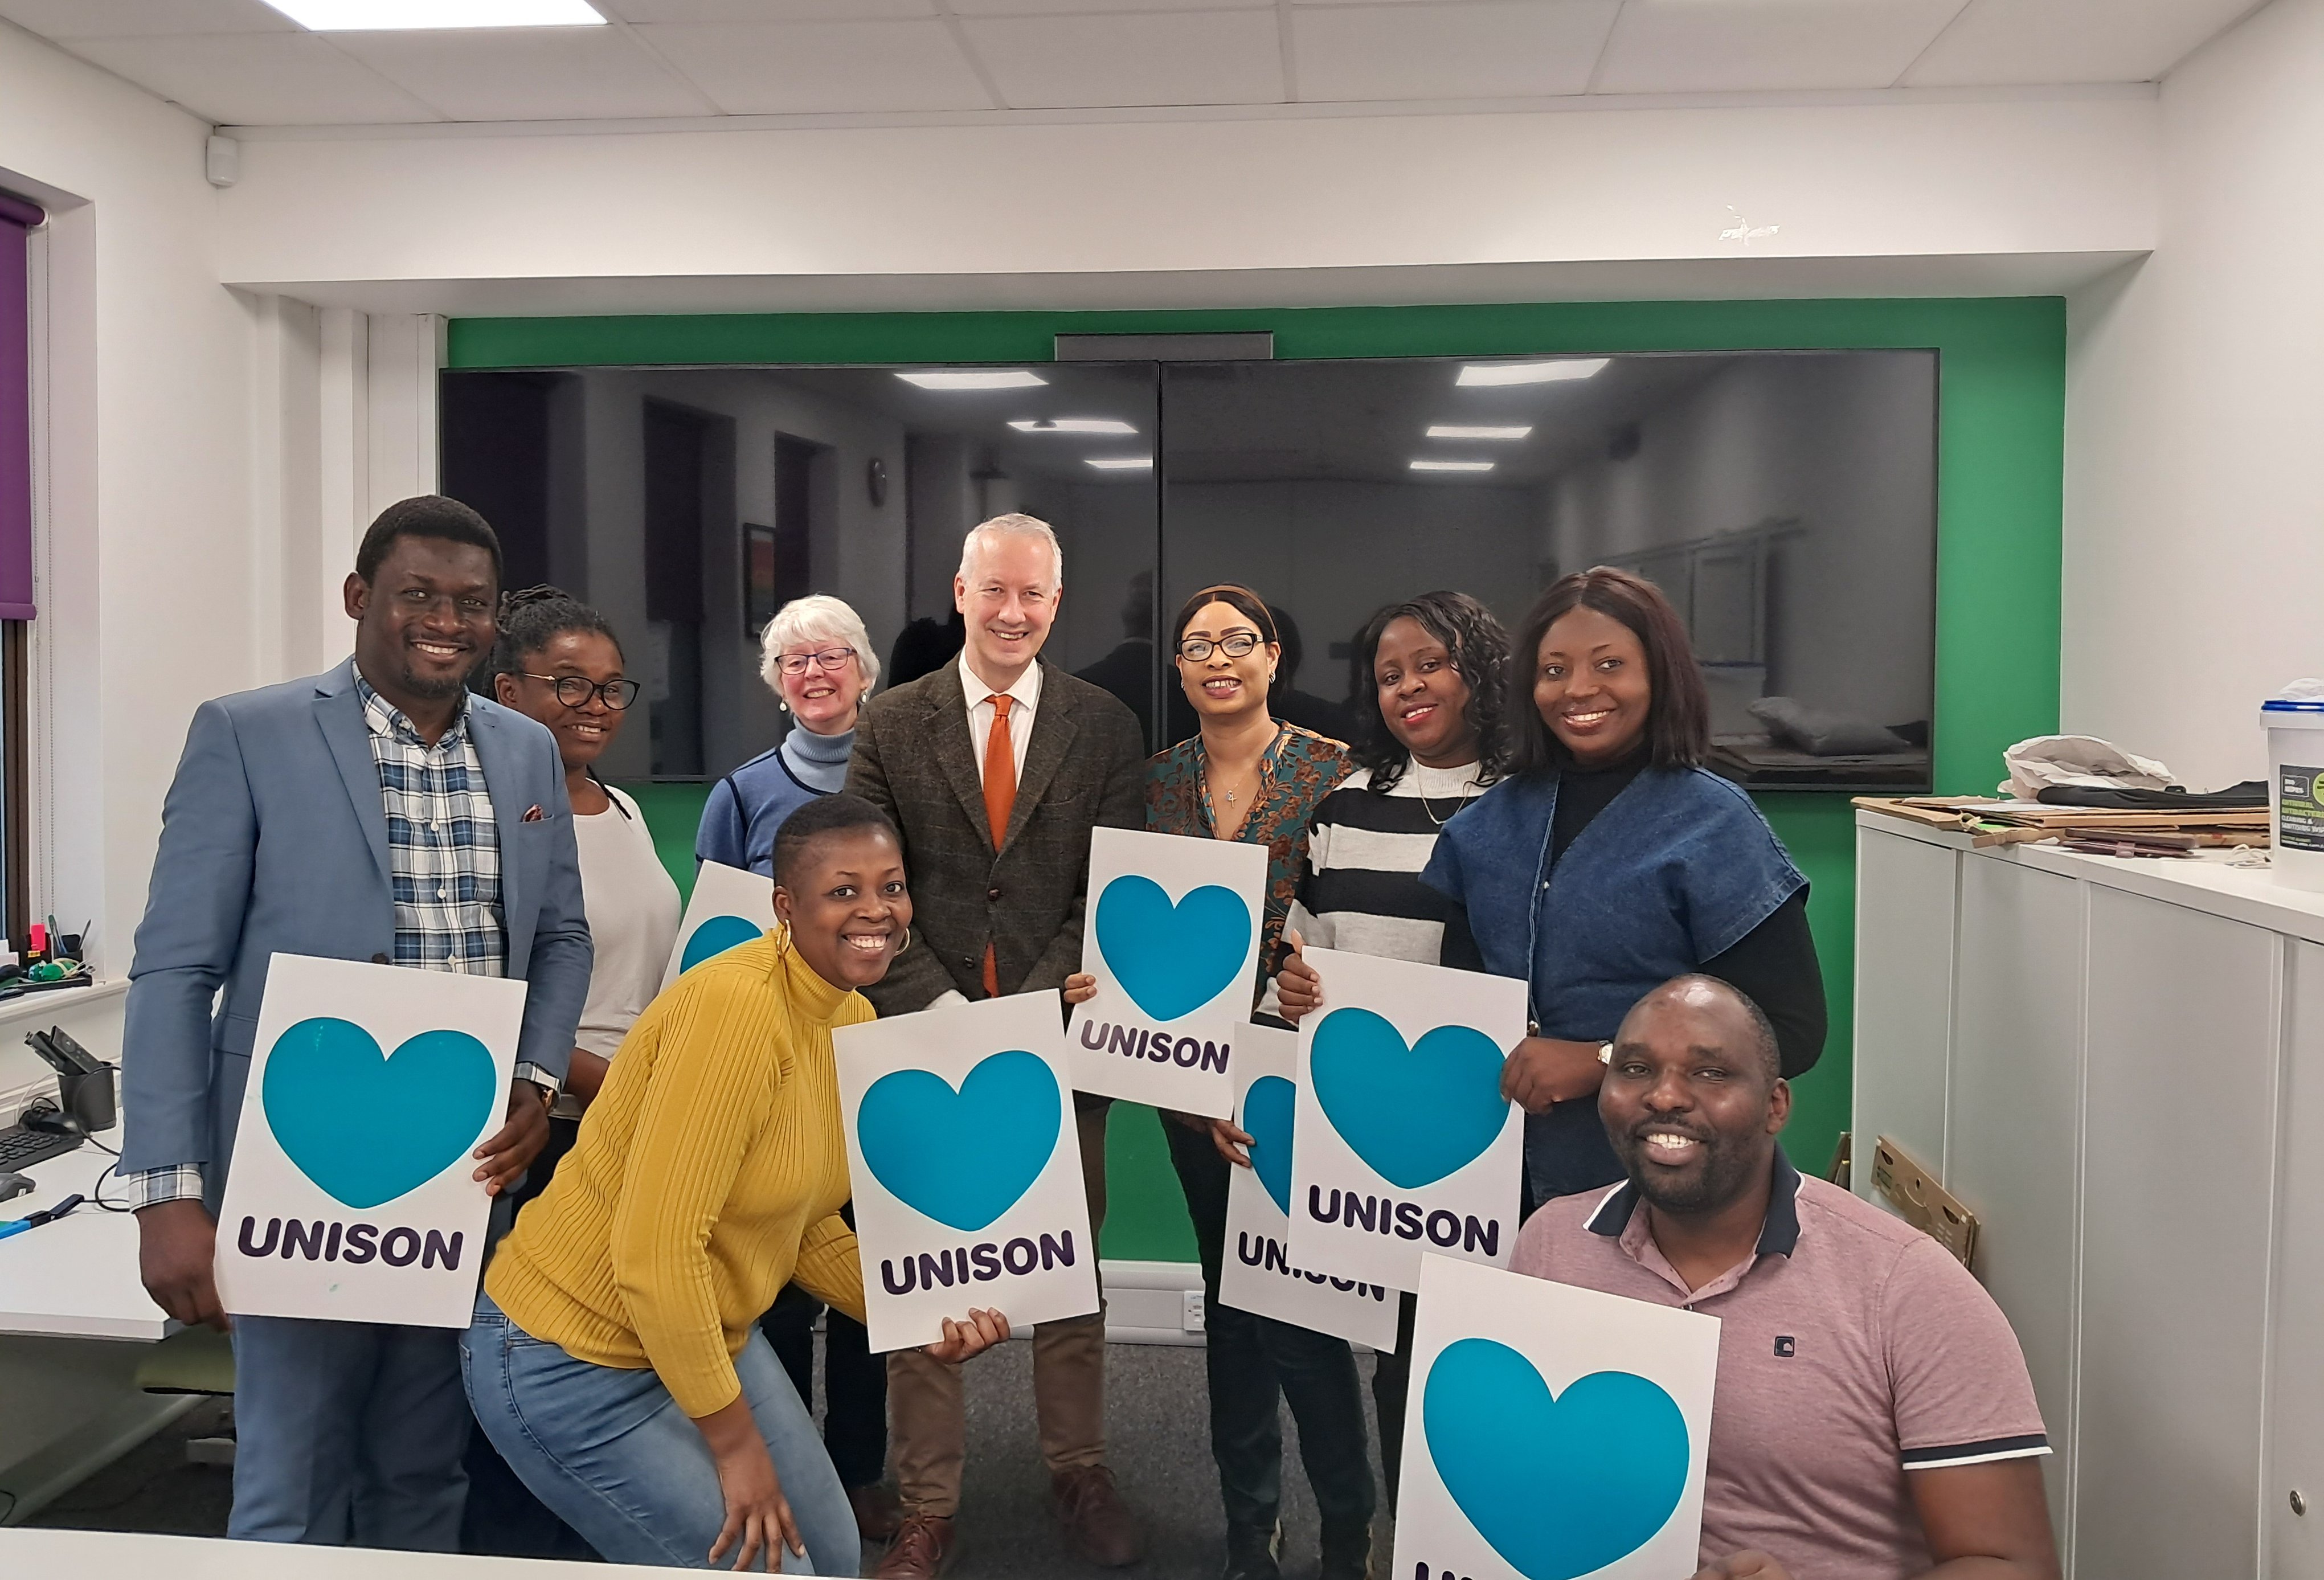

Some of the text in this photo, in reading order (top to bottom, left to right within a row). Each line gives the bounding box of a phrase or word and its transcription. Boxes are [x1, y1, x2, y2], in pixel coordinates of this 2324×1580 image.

[1081, 1020, 1230, 1074] UNISON
[238, 1215, 464, 1271] UNISON
[1308, 1184, 1499, 1257] UNISON
[881, 1230, 1075, 1295] UNISON
